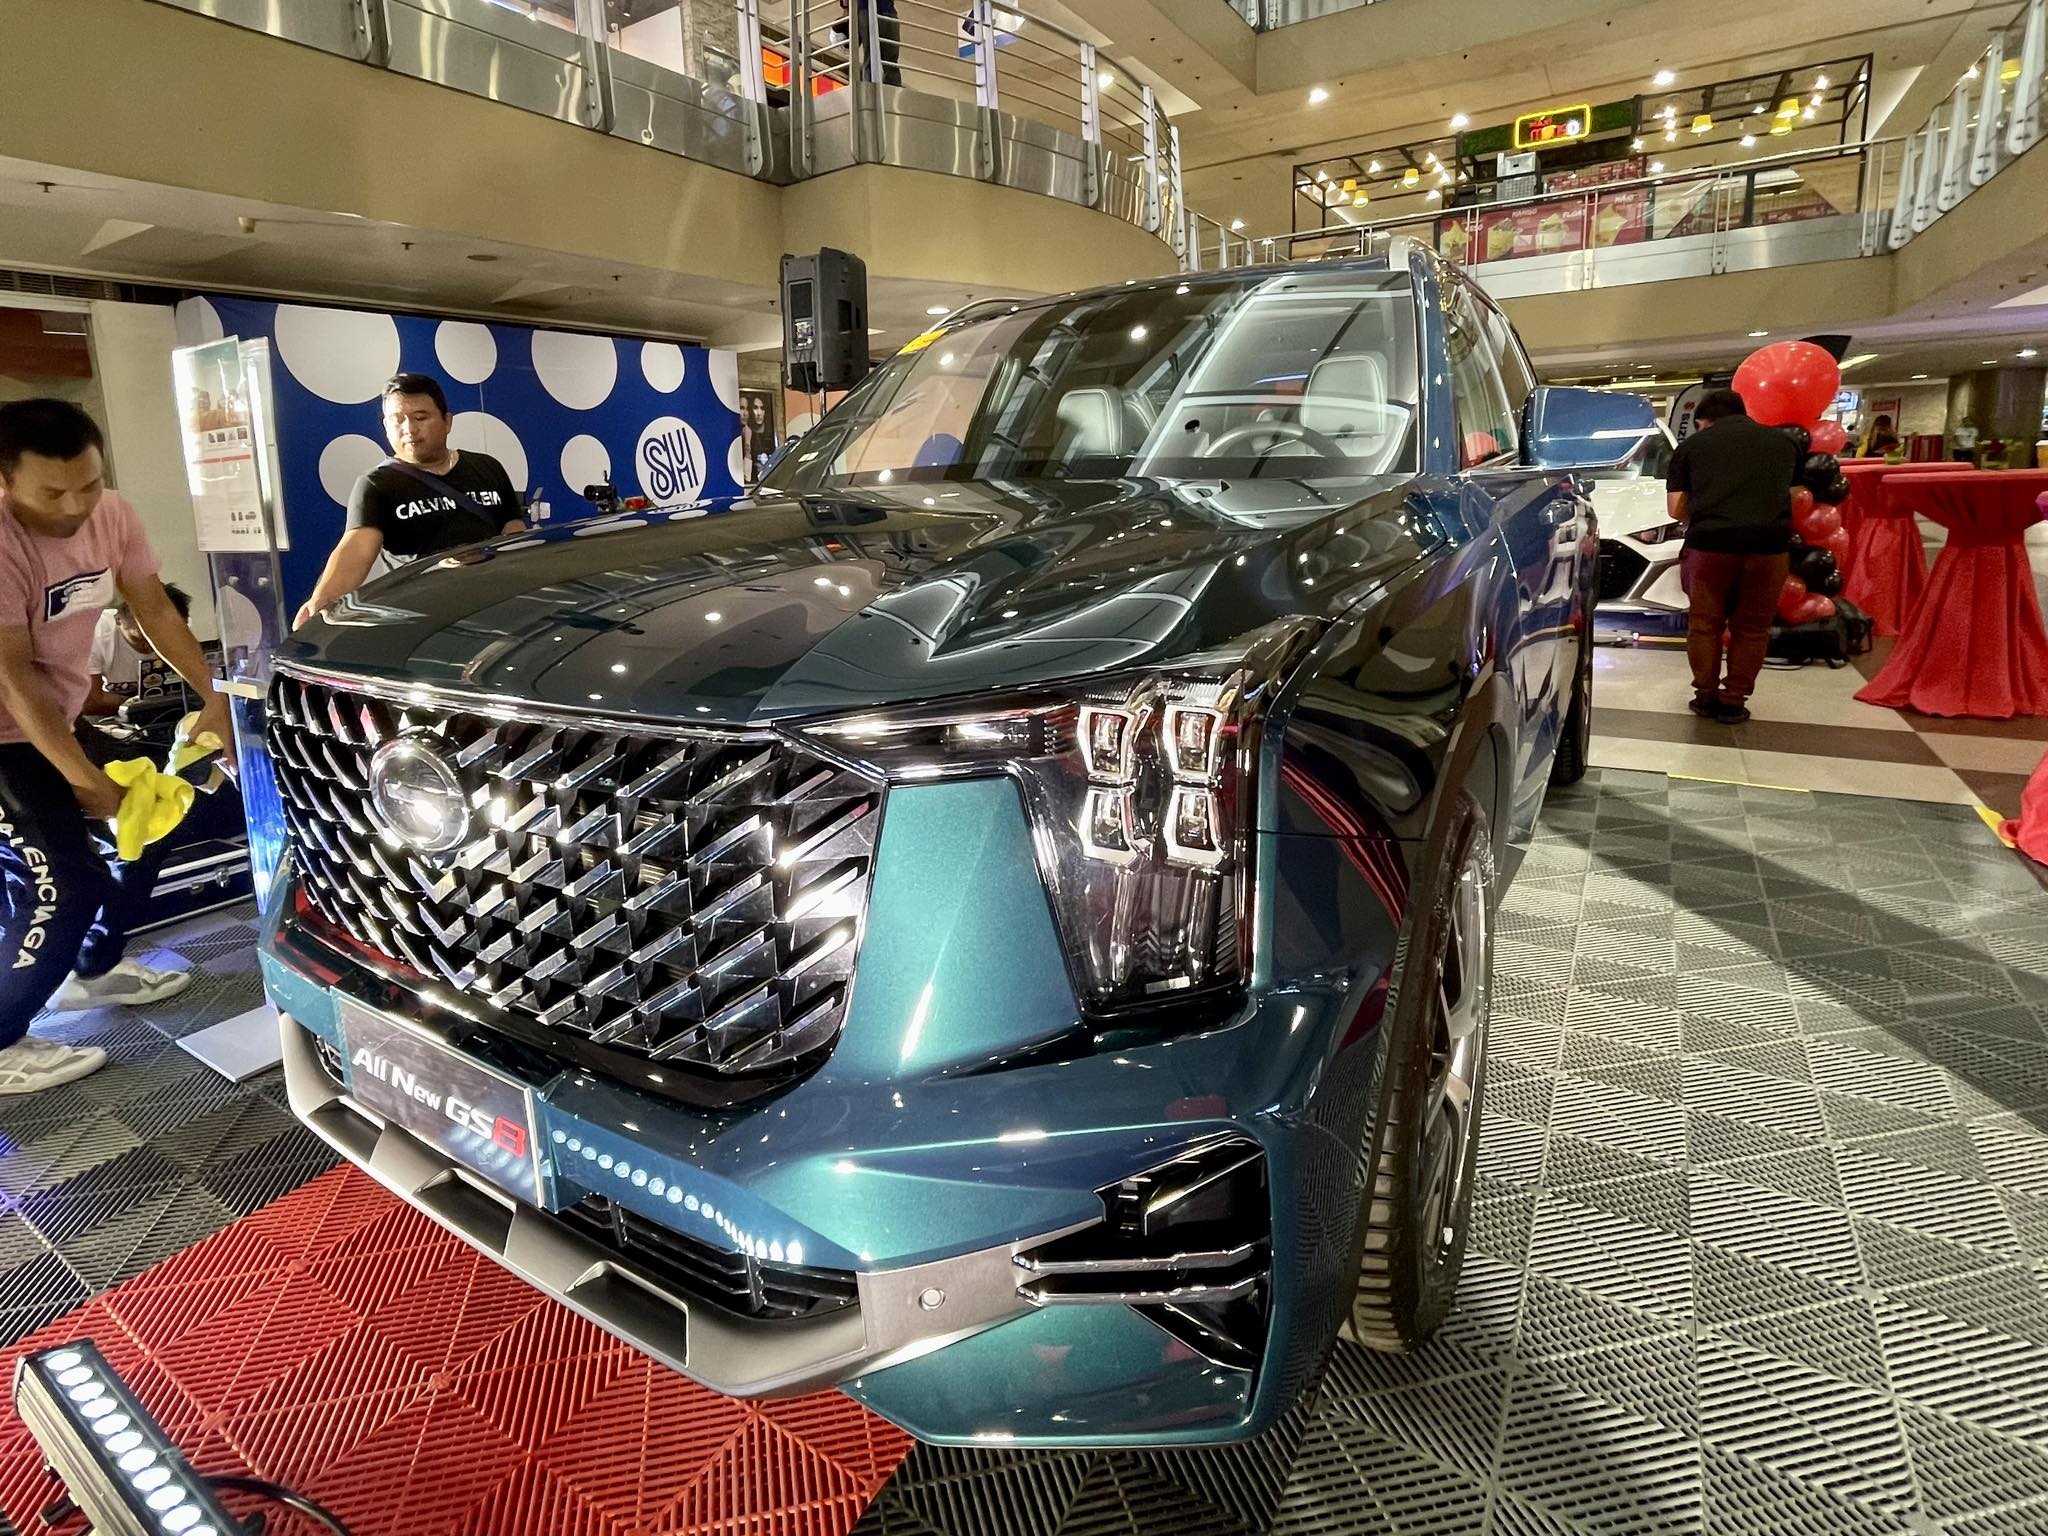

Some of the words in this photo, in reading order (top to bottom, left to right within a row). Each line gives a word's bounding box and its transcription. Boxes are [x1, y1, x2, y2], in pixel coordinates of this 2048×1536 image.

[643, 427, 699, 500] SM
[395, 496, 457, 520] CALVIN
[445, 1096, 527, 1157] GS8
